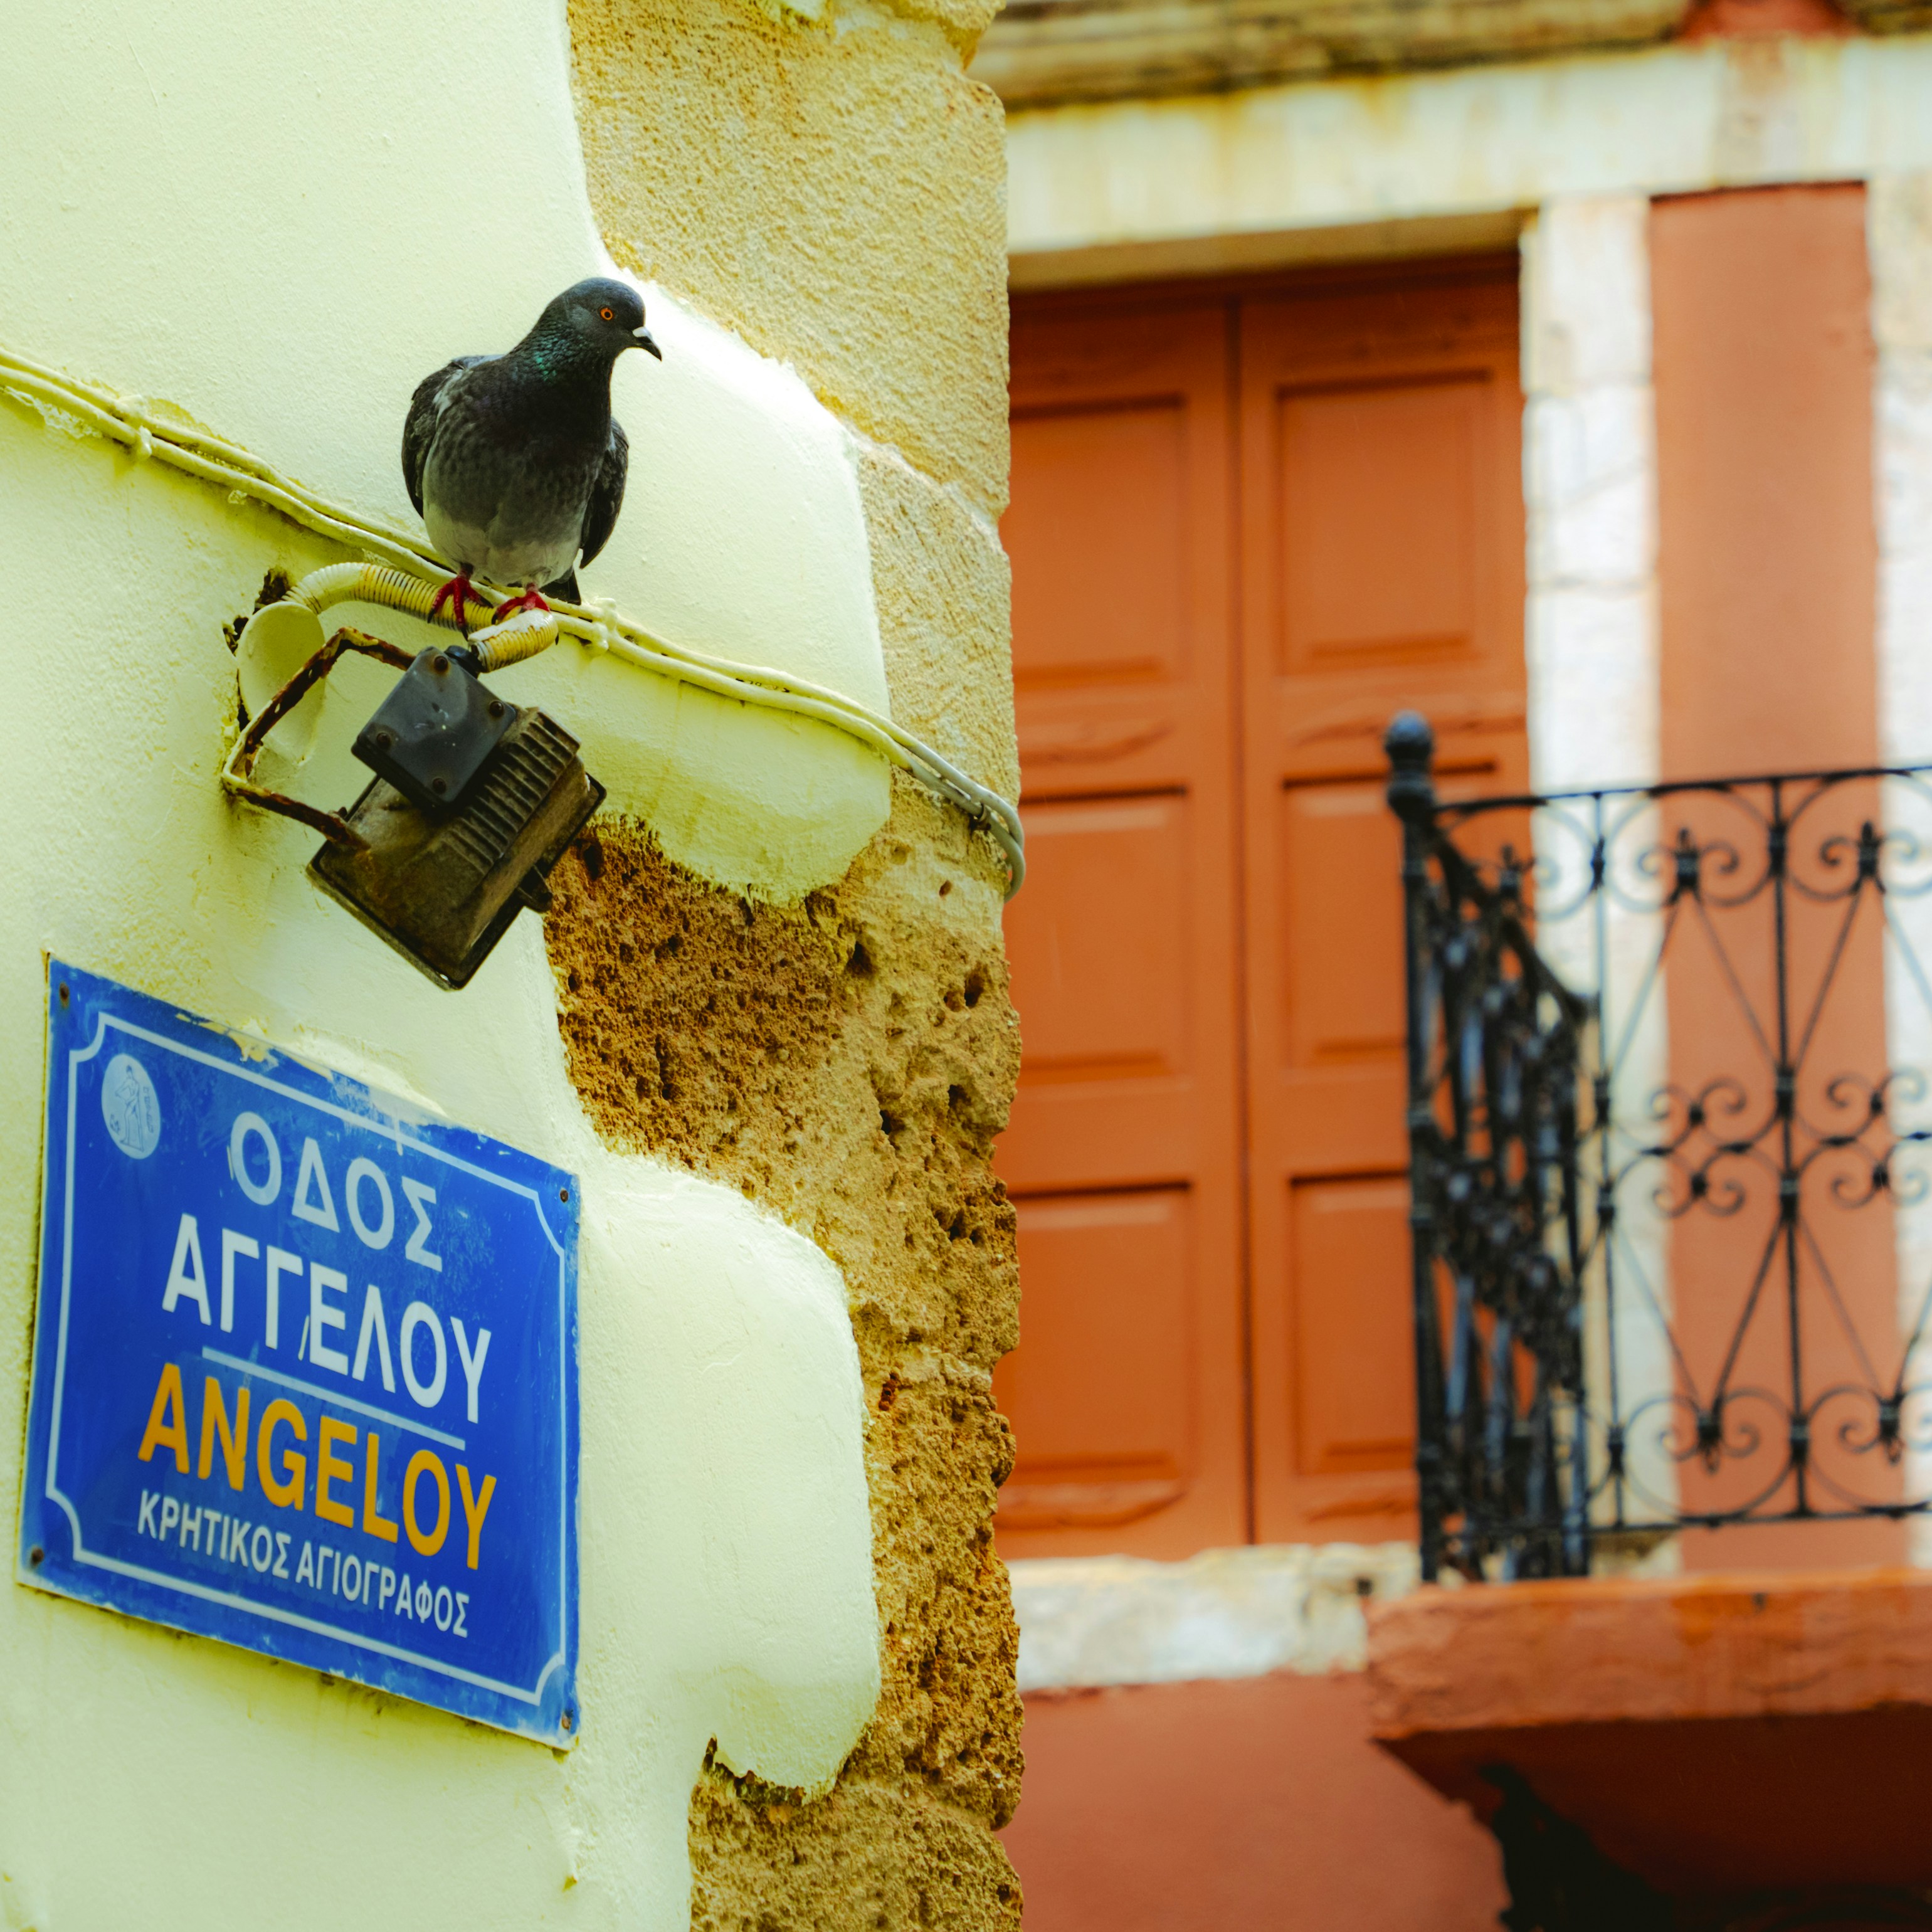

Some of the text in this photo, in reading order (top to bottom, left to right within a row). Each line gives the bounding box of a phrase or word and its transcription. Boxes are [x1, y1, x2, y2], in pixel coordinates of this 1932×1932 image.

[230, 1111, 443, 1273] ΟΔΟΣ
[162, 1213, 492, 1424] ΑΓΓΕΛΟΥ
[137, 1362, 497, 1570] ANGELOY
[137, 1490, 470, 1638] ΚΡΗΤΙΚΟΣ ΑΓΙΟΓΡΑΦΟΣ
